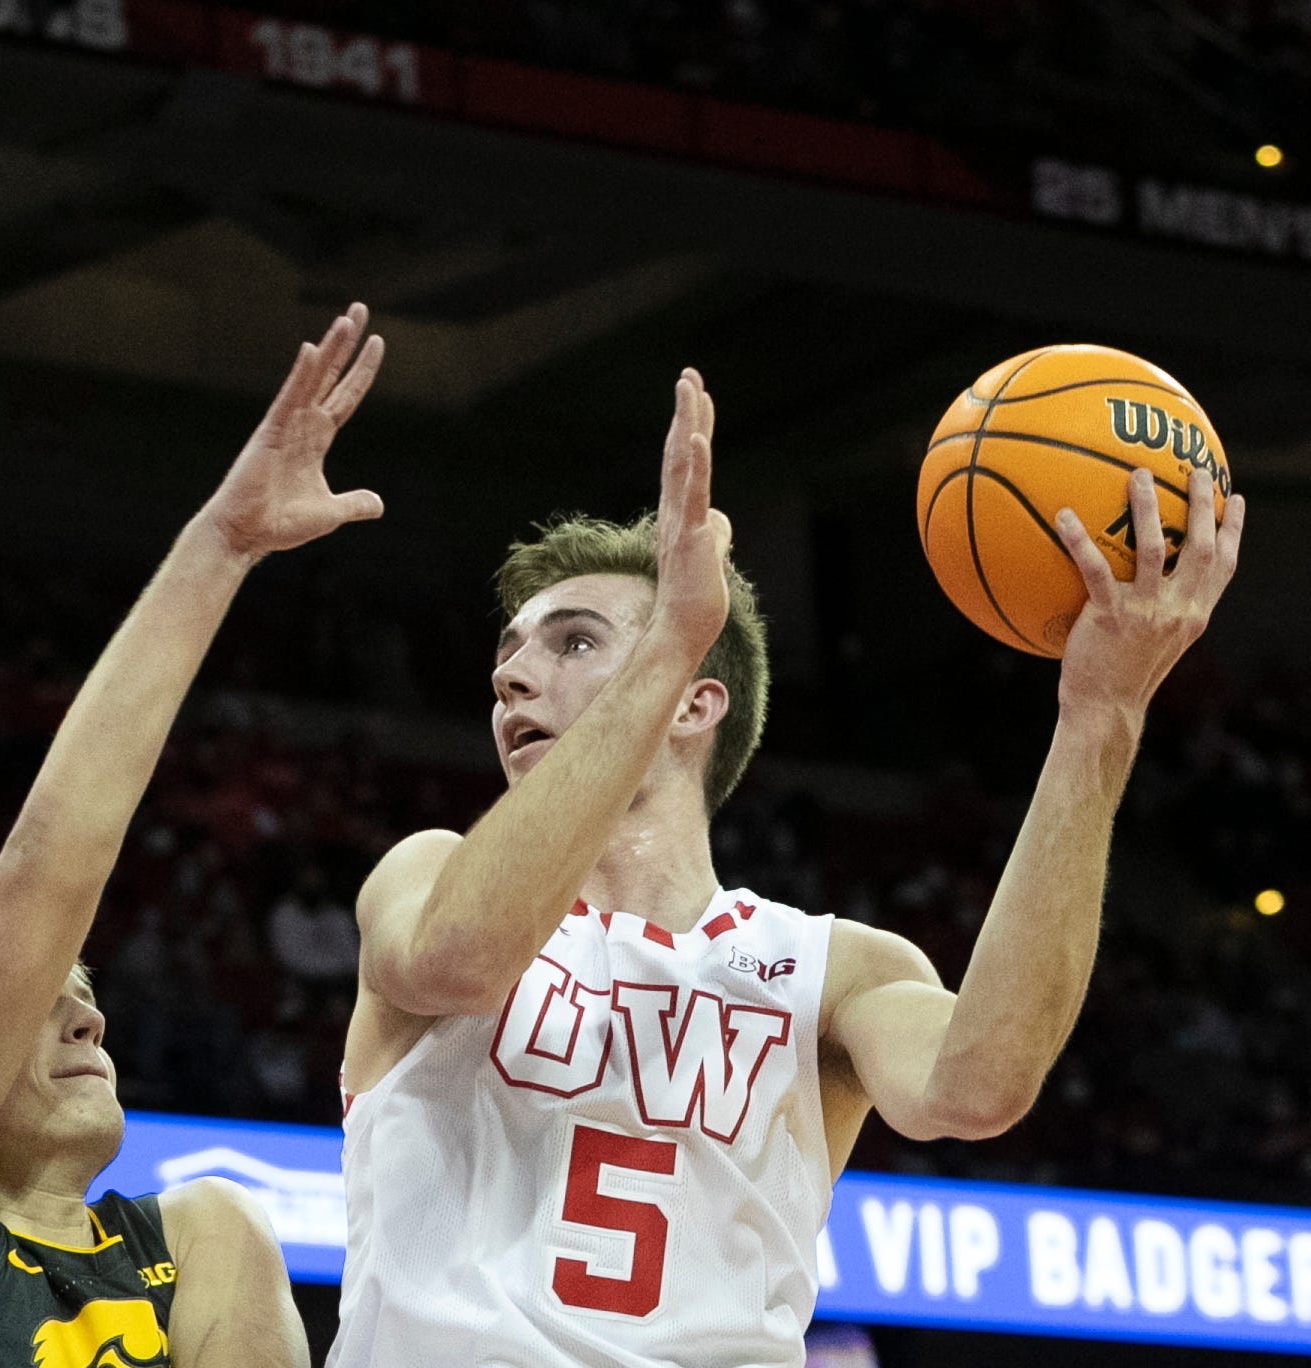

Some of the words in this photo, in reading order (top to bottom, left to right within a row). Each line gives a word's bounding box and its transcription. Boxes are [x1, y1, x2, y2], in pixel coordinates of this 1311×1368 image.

[249, 18, 419, 101] 1941
[1104, 397, 1232, 499] Wilso
[490, 955, 792, 1145] UW
[552, 1125, 677, 1318] 5
[861, 1198, 1000, 1299] VIP
